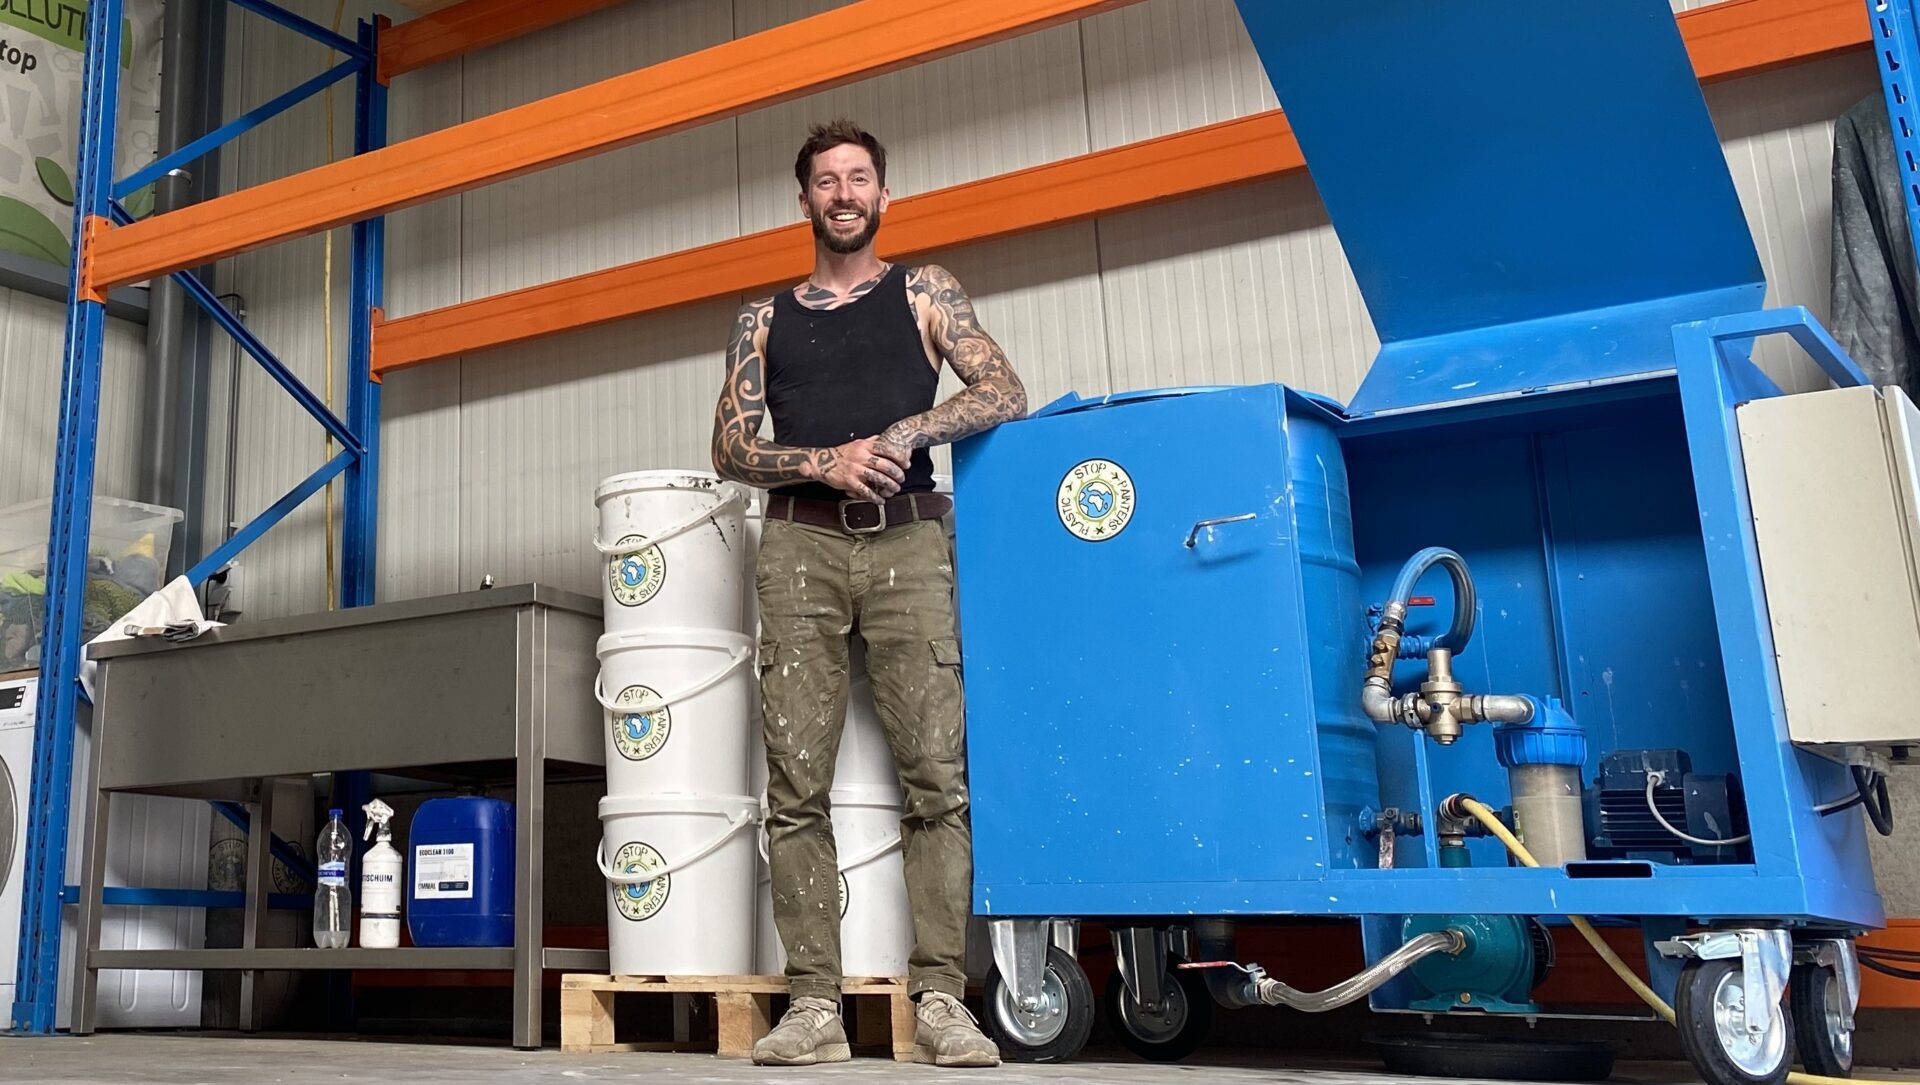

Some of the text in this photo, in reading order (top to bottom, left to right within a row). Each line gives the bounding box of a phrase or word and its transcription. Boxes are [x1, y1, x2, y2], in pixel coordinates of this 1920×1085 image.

[1074, 462, 1107, 480] STOP
[1061, 497, 1090, 536] PLASTIC
[1108, 480, 1131, 531] PANTERS
[639, 556, 661, 599] PANTERS
[623, 688, 649, 702] STOP
[643, 707, 667, 753] PANTERS
[622, 845, 648, 859] STOP
[643, 876, 666, 914] ANTERS
